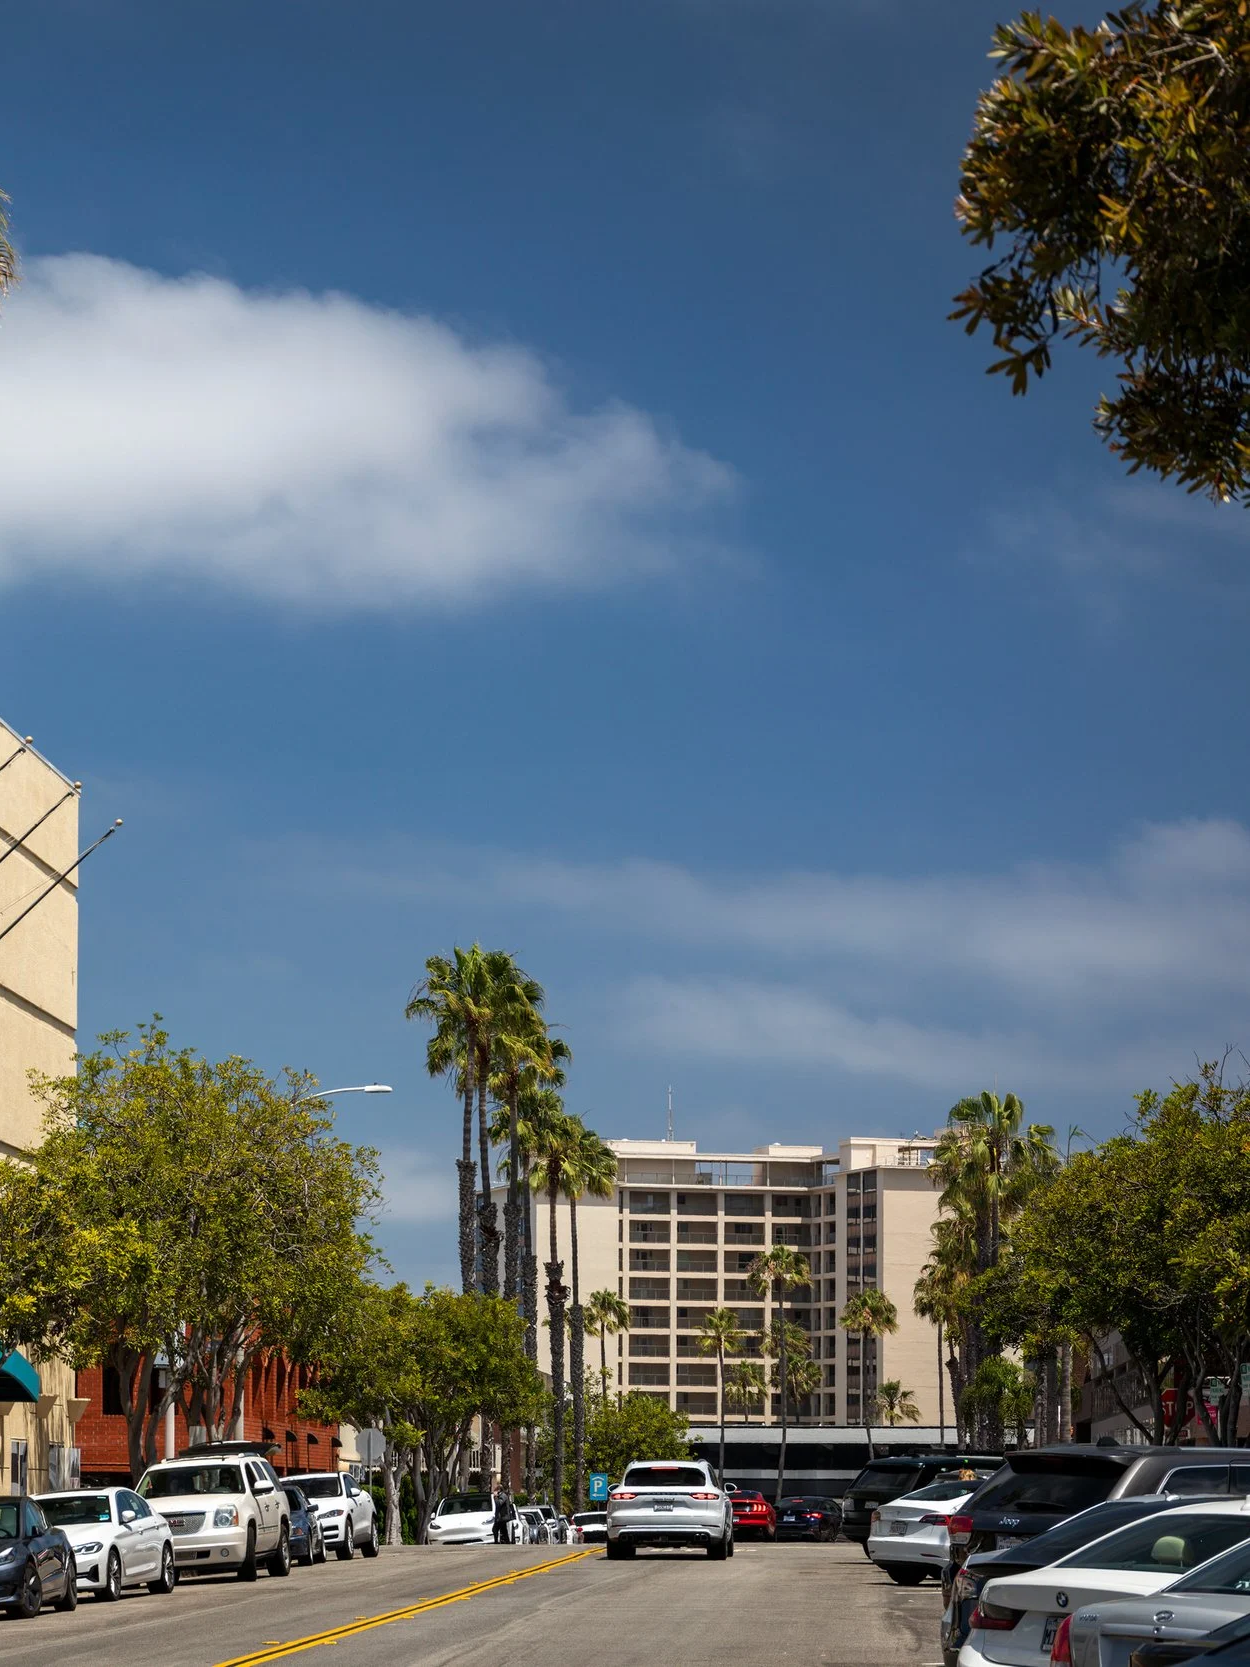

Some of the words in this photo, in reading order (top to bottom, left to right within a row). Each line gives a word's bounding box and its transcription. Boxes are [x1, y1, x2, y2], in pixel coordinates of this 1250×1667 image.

[1161, 1401, 1194, 1416] STP
[594, 1481, 603, 1493] P
[999, 1516, 1020, 1528] Jeep
